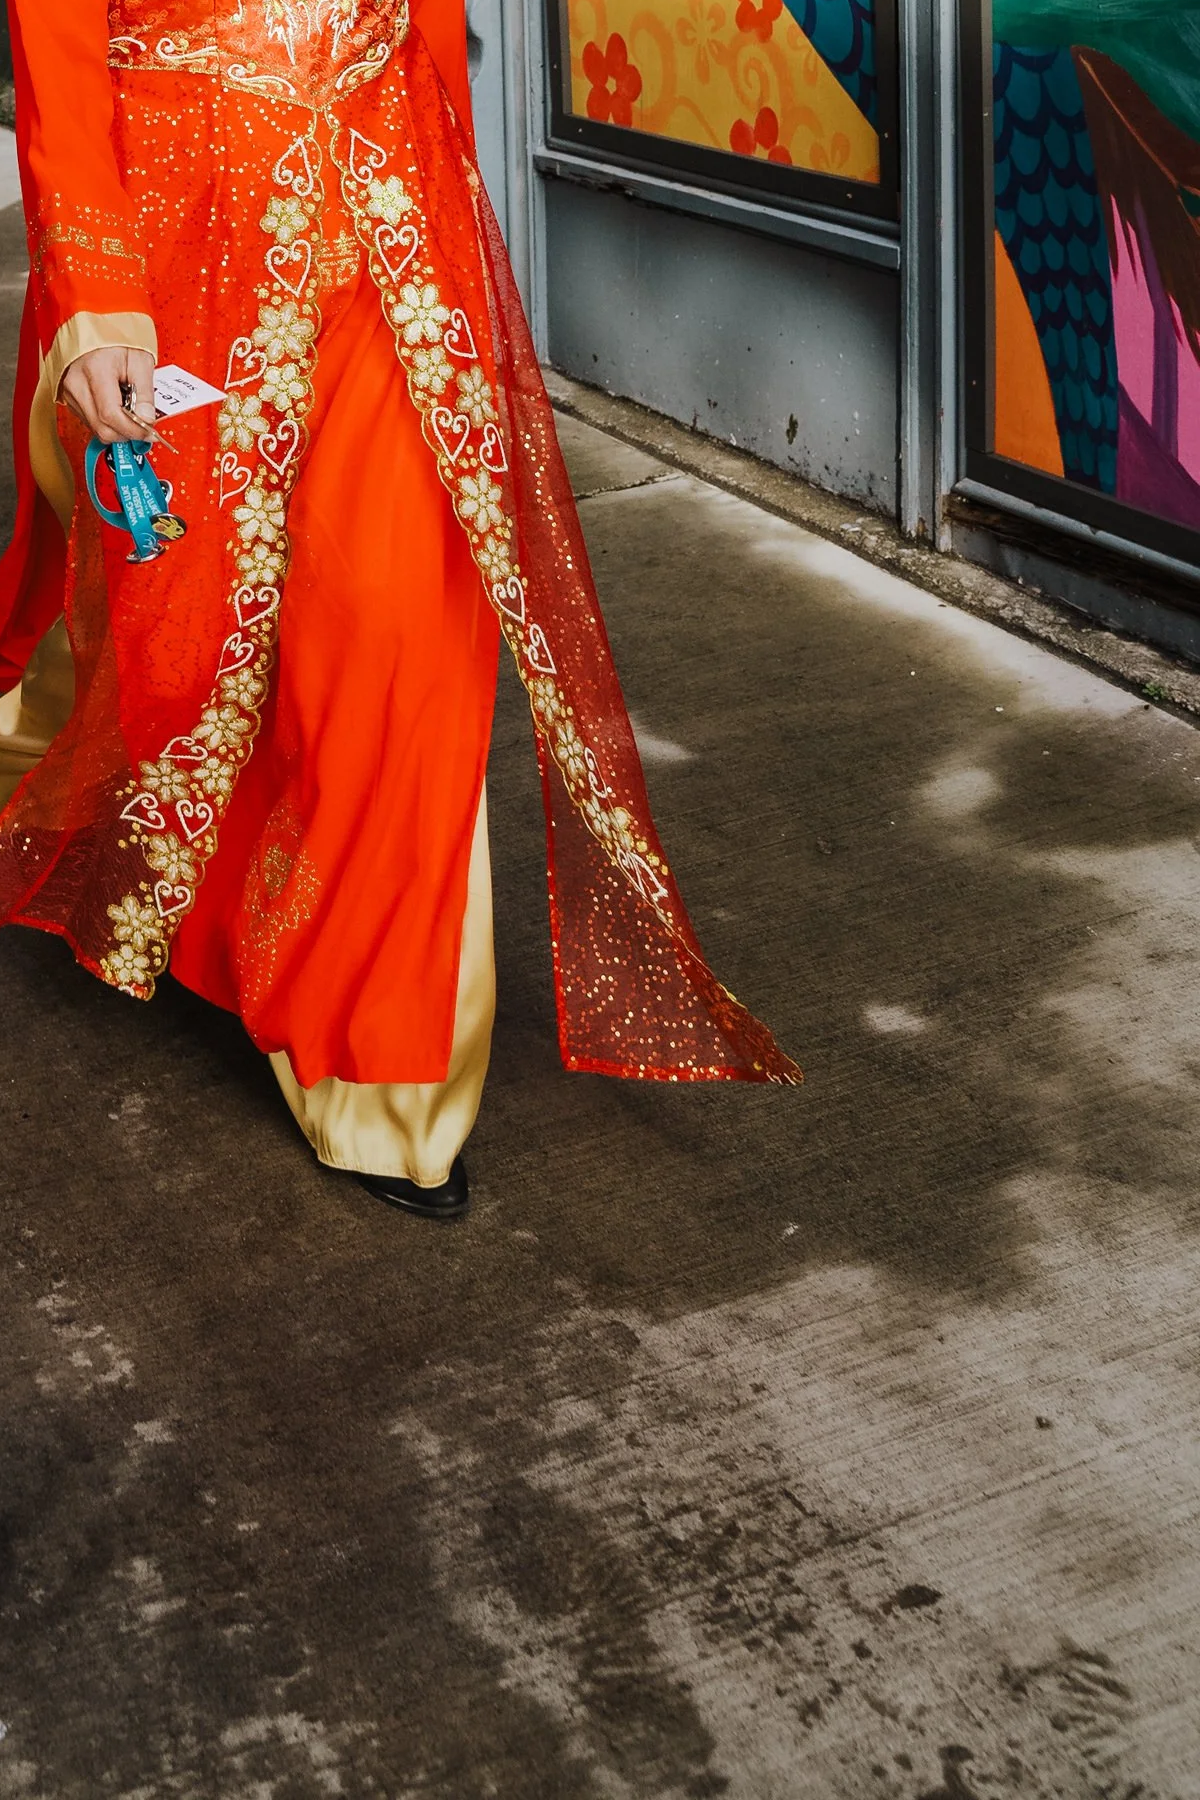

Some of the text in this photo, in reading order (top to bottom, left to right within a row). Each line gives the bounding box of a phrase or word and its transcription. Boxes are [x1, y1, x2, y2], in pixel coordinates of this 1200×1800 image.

[173, 378, 196, 391] Staff
[153, 387, 180, 405] Le-
[117, 443, 125, 464] BRUC
[138, 478, 152, 499] WING
[120, 485, 138, 526] WING LUKE
[131, 486, 145, 518] MUSEUM
